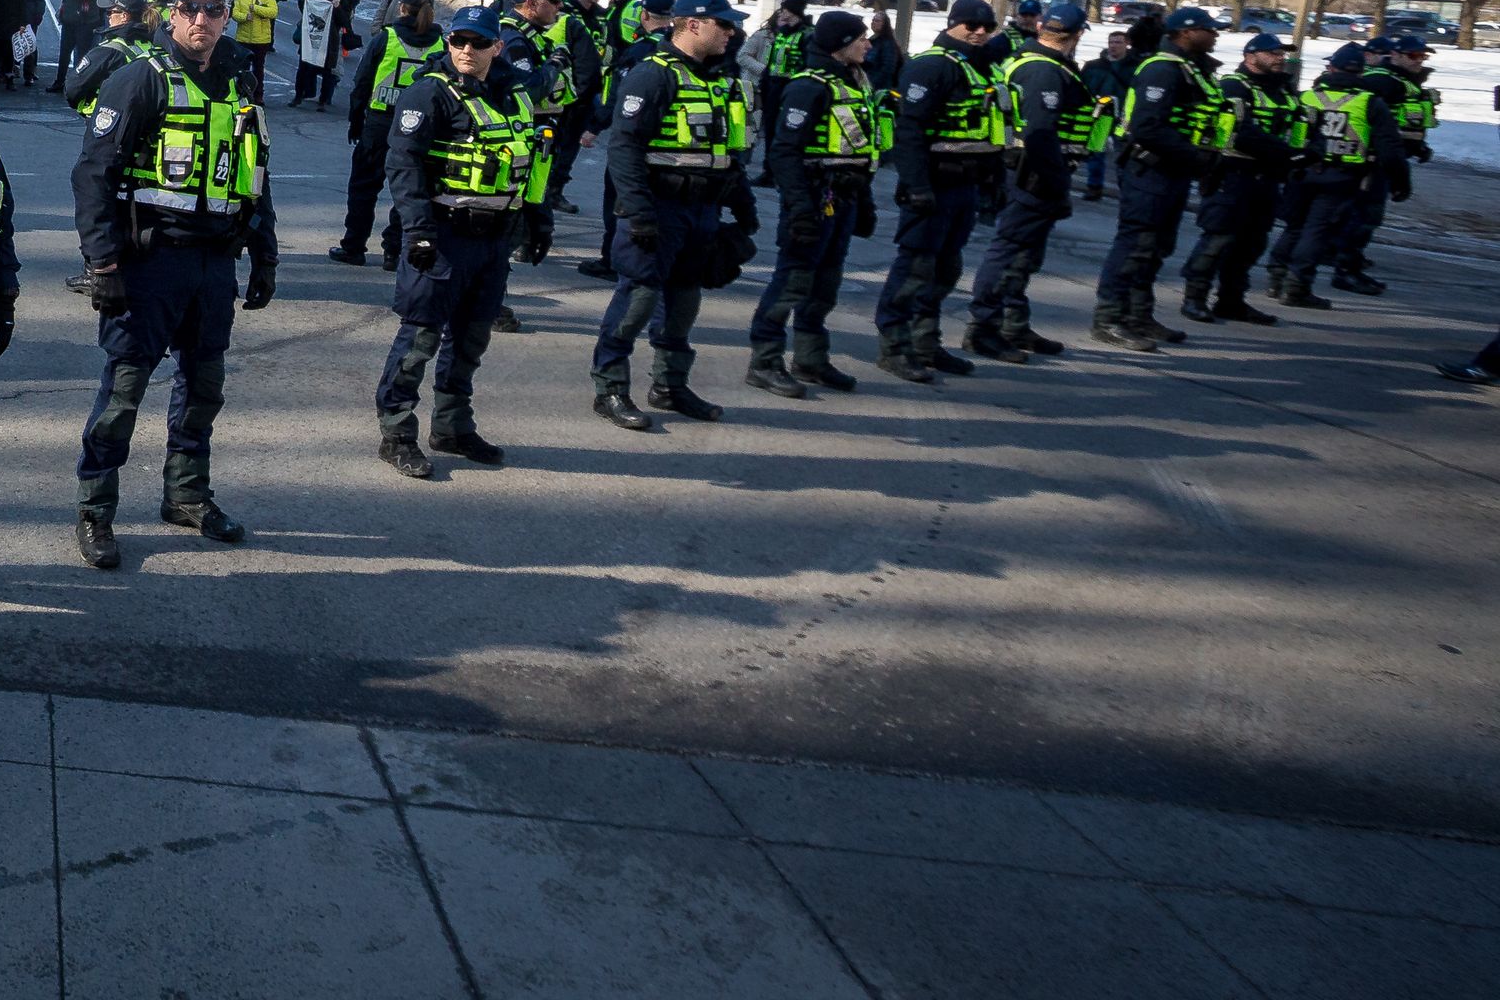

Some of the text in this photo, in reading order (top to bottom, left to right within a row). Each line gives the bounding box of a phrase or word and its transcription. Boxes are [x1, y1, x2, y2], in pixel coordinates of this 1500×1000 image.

[98, 107, 117, 118] POLICE
[218, 151, 229, 166] A
[214, 165, 228, 180] 22
